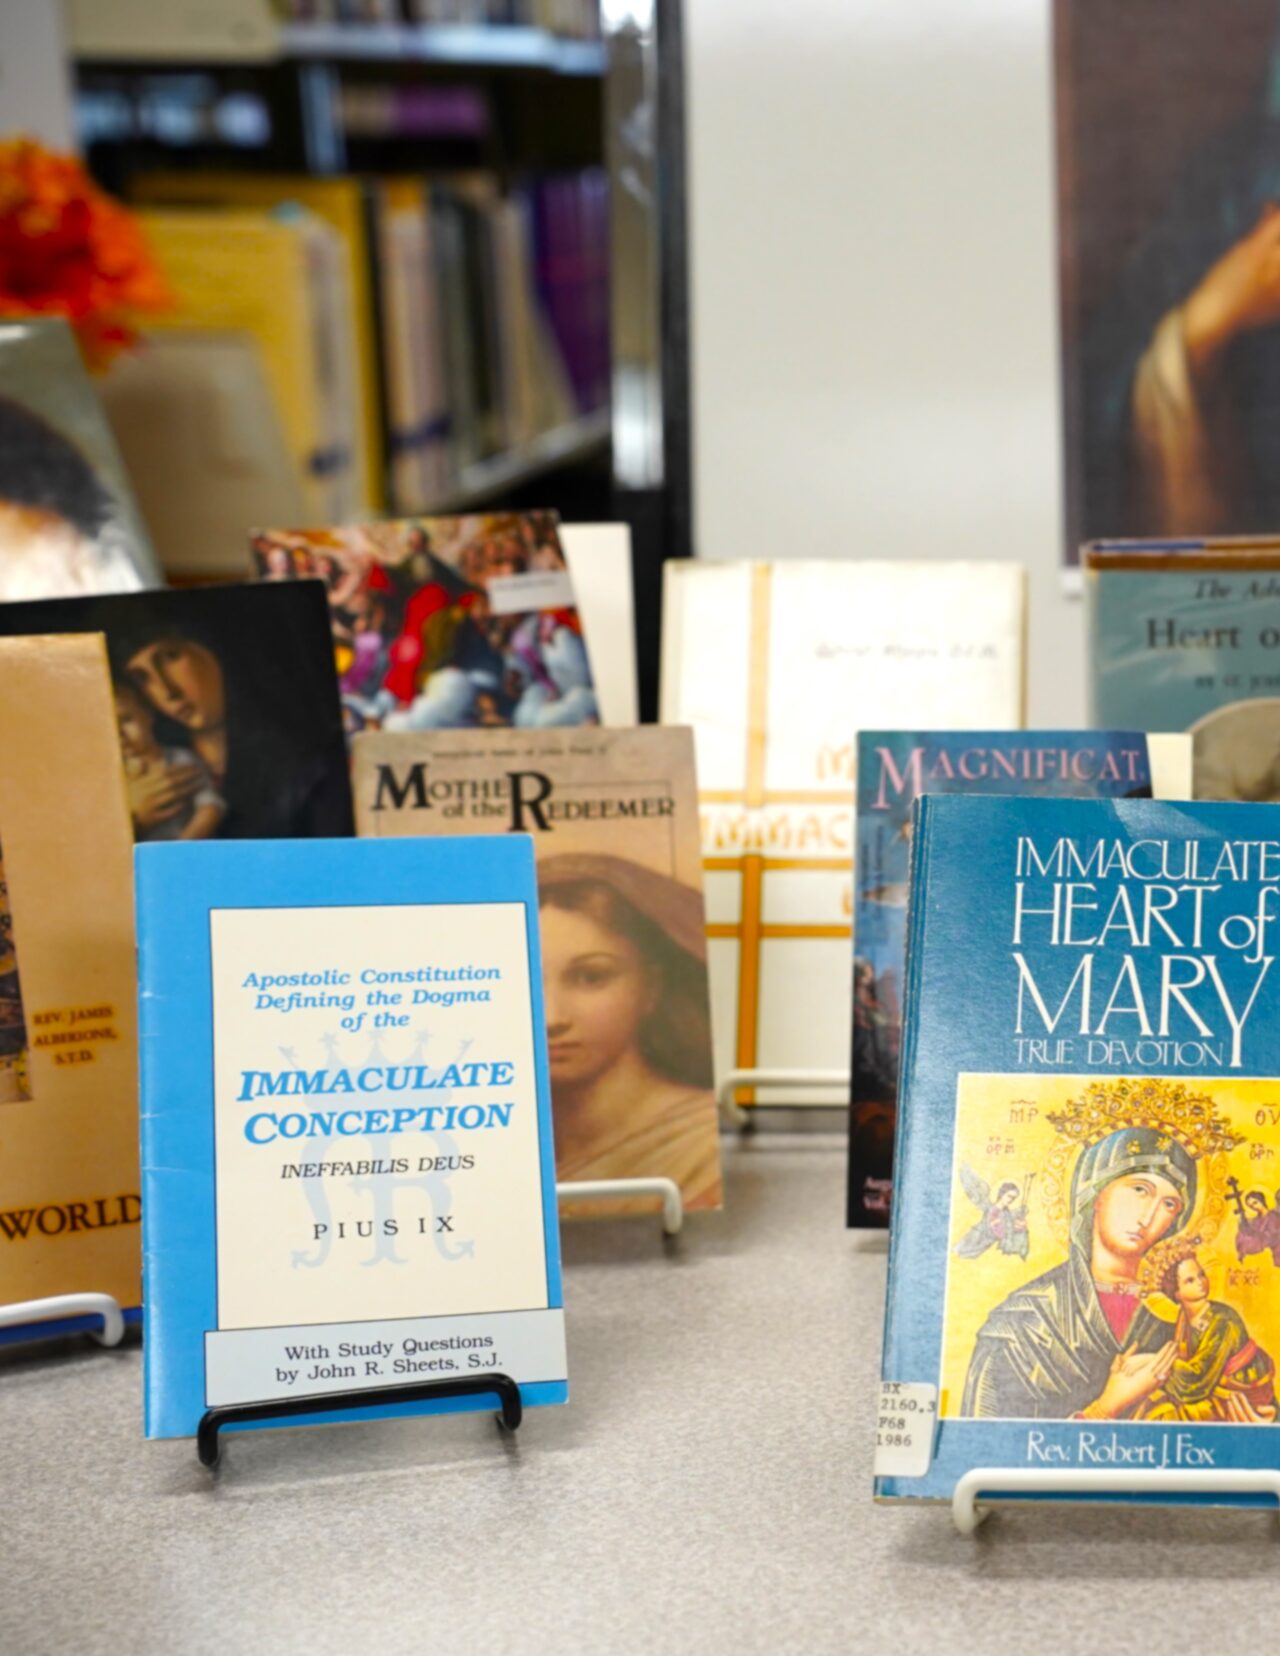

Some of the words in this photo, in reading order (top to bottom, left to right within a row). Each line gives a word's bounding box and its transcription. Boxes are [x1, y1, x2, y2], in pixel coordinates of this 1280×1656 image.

[1194, 579, 1231, 600] The
[1145, 616, 1240, 650] Heart
[870, 746, 1140, 810] MAGNIFICAT
[442, 804, 464, 819] of
[471, 802, 507, 818] the
[1012, 882, 1223, 948] HEART
[1218, 886, 1280, 964] of
[242, 969, 350, 991] Apostolic
[360, 965, 502, 985] Constitution
[254, 990, 356, 1013] Defining
[366, 989, 402, 1006] the
[412, 988, 491, 1007] Dogma
[1012, 952, 1275, 1068] MARY
[340, 1011, 367, 1033] of
[373, 1012, 410, 1028] the
[1014, 1038, 1074, 1065] TRUE
[1087, 1039, 1224, 1066] DEVOTION
[236, 1060, 515, 1102] IMMACULATE
[243, 1102, 514, 1145] CONCEPTION
[280, 1158, 410, 1180] INEFFABILIS
[417, 1155, 475, 1173] DEUS
[0, 1194, 142, 1242] WORLD
[313, 1217, 399, 1241] PIUS
[418, 1215, 455, 1234] IX
[284, 1344, 330, 1362] With
[337, 1339, 394, 1360] Study
[402, 1334, 494, 1356] Questions
[275, 1365, 299, 1385] by
[307, 1362, 356, 1381] John
[364, 1360, 384, 1376] R.
[467, 1352, 504, 1369] S.J.
[876, 1433, 912, 1447] 1986
[1027, 1430, 1071, 1462] Rev.
[1078, 1431, 1156, 1463] Robert
[1175, 1433, 1215, 1465] Fox
